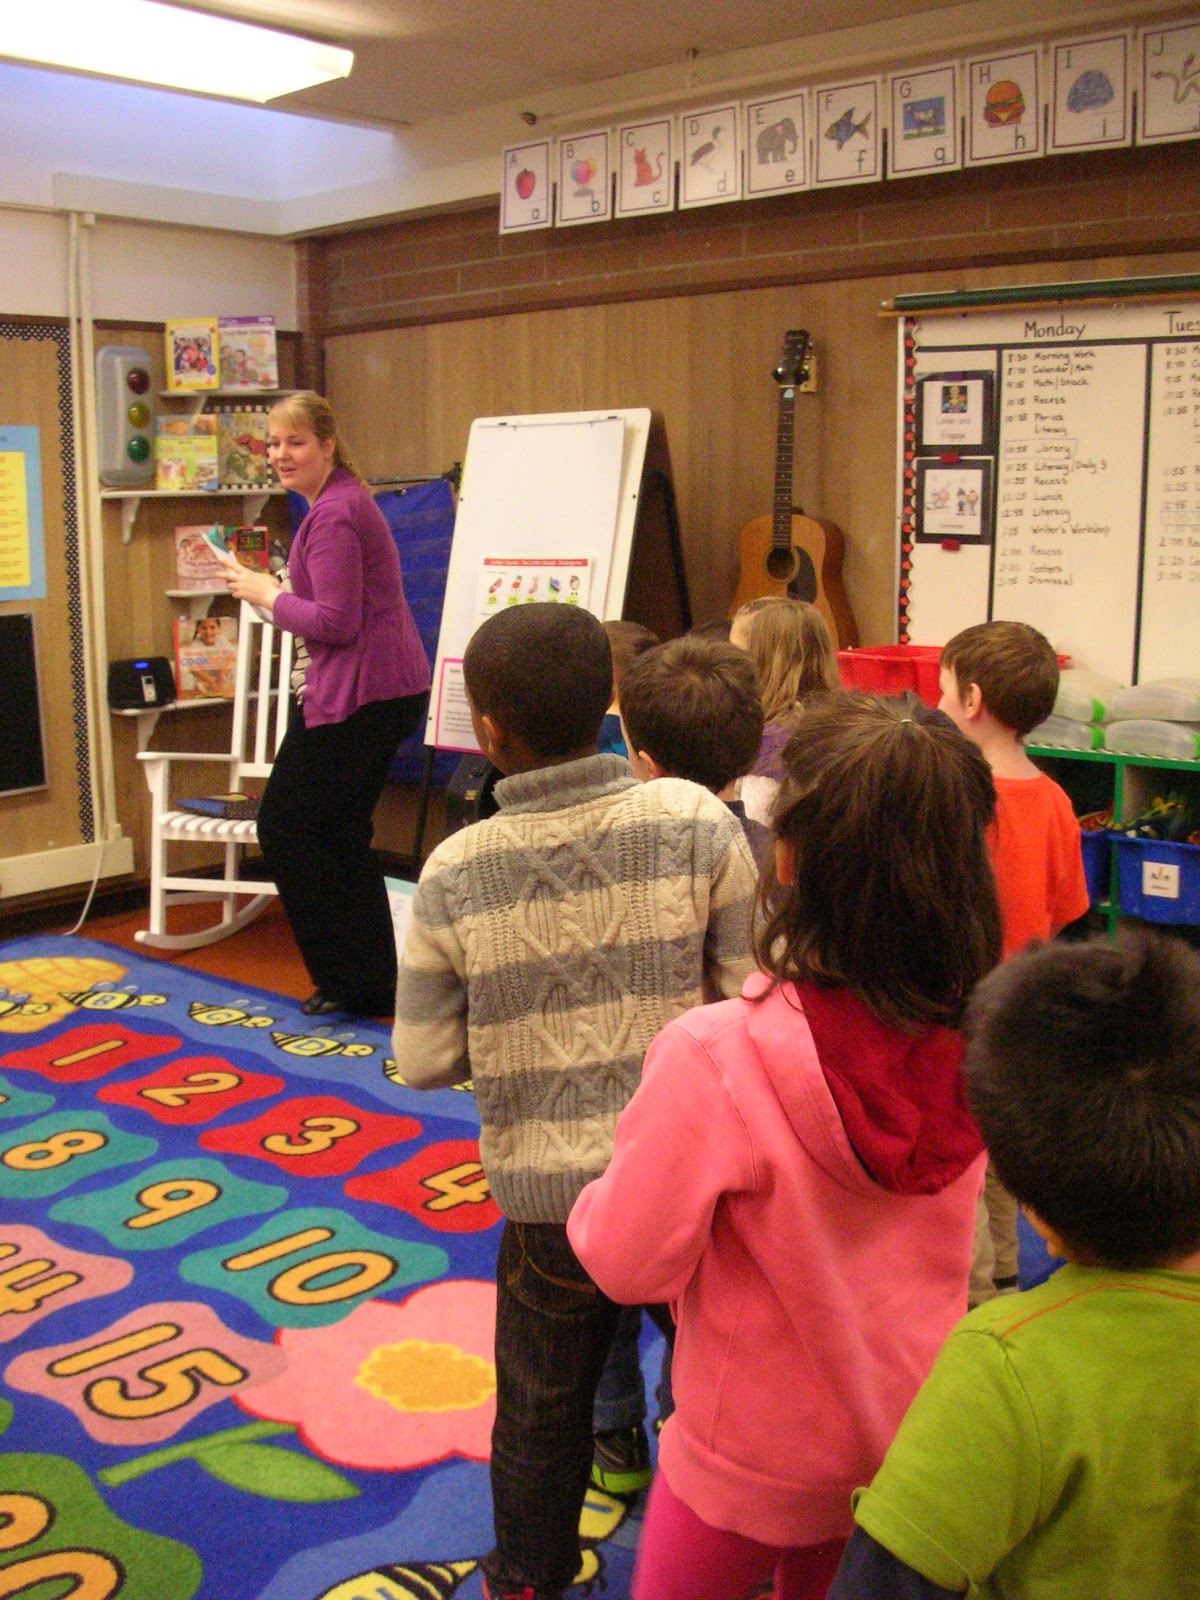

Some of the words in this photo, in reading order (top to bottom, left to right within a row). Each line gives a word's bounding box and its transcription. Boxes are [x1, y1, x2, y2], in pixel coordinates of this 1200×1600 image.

[1152, 35, 1164, 56] J
[979, 65, 992, 85] H
[899, 80, 913, 99] G
[824, 92, 835, 111] F
[754, 107, 766, 126] E
[690, 119, 700, 137] D
[625, 131, 636, 147] C
[1013, 125, 1027, 150] h
[508, 152, 520, 169] A
[565, 144, 575, 159] B
[933, 147, 947, 166] g
[856, 149, 868, 173] f
[715, 170, 728, 193] d
[784, 168, 796, 184] e
[591, 199, 601, 213] b
[652, 191, 662, 204] c
[531, 208, 541, 221] a
[1023, 313, 1087, 341] Monday
[1034, 351, 1071, 366] Morning
[1073, 350, 1096, 359] Work
[1033, 395, 1067, 405] Recess
[1033, 476, 1068, 486] Recess
[1033, 491, 1064, 501] Lunch
[1032, 506, 1072, 524] Literacy
[1030, 544, 1063, 557] Recess
[1028, 573, 1074, 586] Dismissal
[292, 1039, 327, 1052] D
[49, 1037, 130, 1069] 1
[137, 1069, 244, 1109] 2
[259, 1113, 363, 1158] 3
[419, 1160, 492, 1213] 4
[1, 1128, 111, 1173] 8
[123, 1177, 225, 1232] 9
[220, 1225, 400, 1307] 10
[0, 1242, 85, 1316] 4
[45, 1321, 250, 1422] 15
